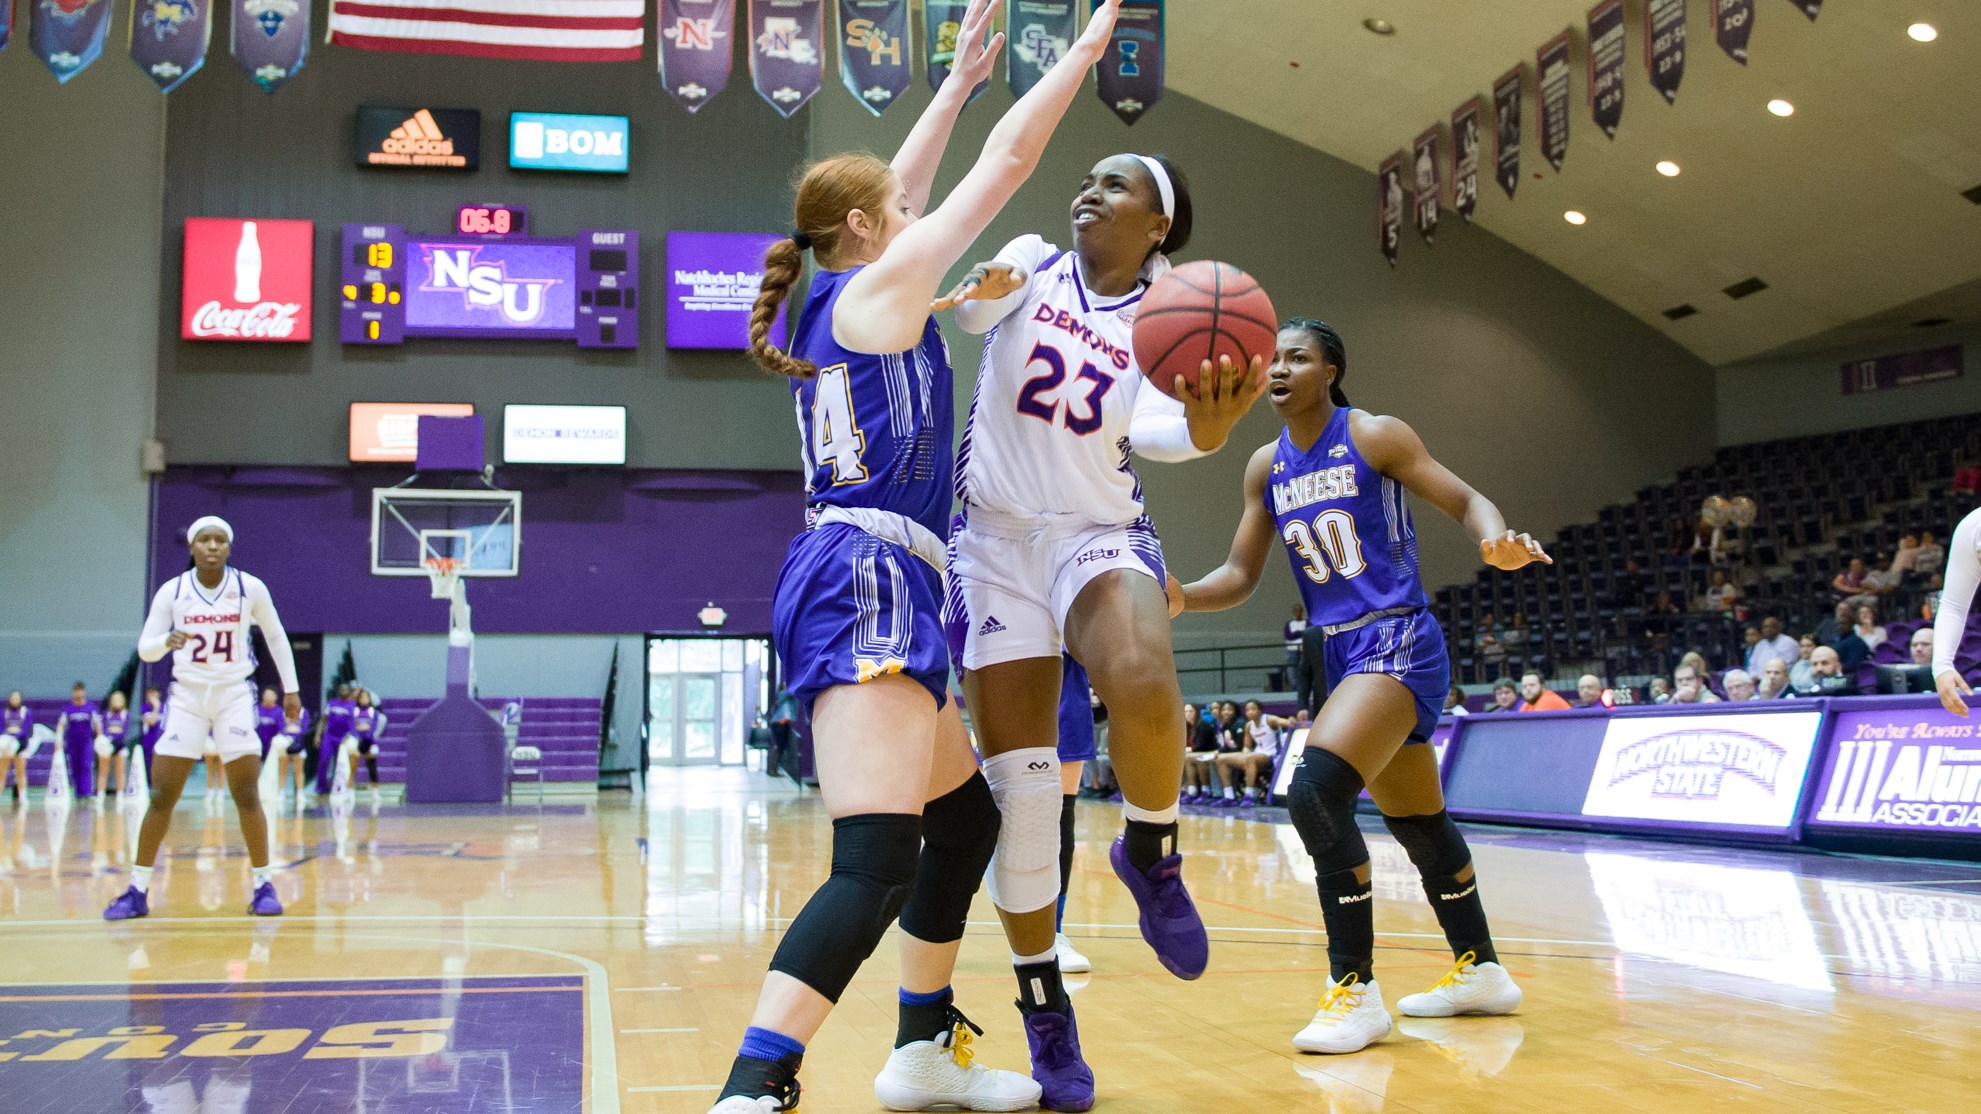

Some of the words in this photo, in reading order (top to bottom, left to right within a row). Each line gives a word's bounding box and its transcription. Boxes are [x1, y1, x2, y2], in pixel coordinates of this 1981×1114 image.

[382, 137, 454, 154] adidas
[545, 129, 623, 156] BOM
[592, 232, 625, 245] GUEST
[368, 242, 393, 268] 13
[432, 248, 544, 323] NSU
[1032, 302, 1130, 371] DEMONS
[1016, 338, 1117, 437] 23
[1272, 463, 1360, 516] McNEESE
[1076, 548, 1121, 568] NSU
[1283, 508, 1368, 584] 30
[183, 613, 241, 625] DEMONS
[978, 623, 1007, 637] adidas
[191, 630, 234, 664] 24
[1611, 730, 1785, 786] NORTHWESTERN
[1652, 764, 1723, 796] STATE
